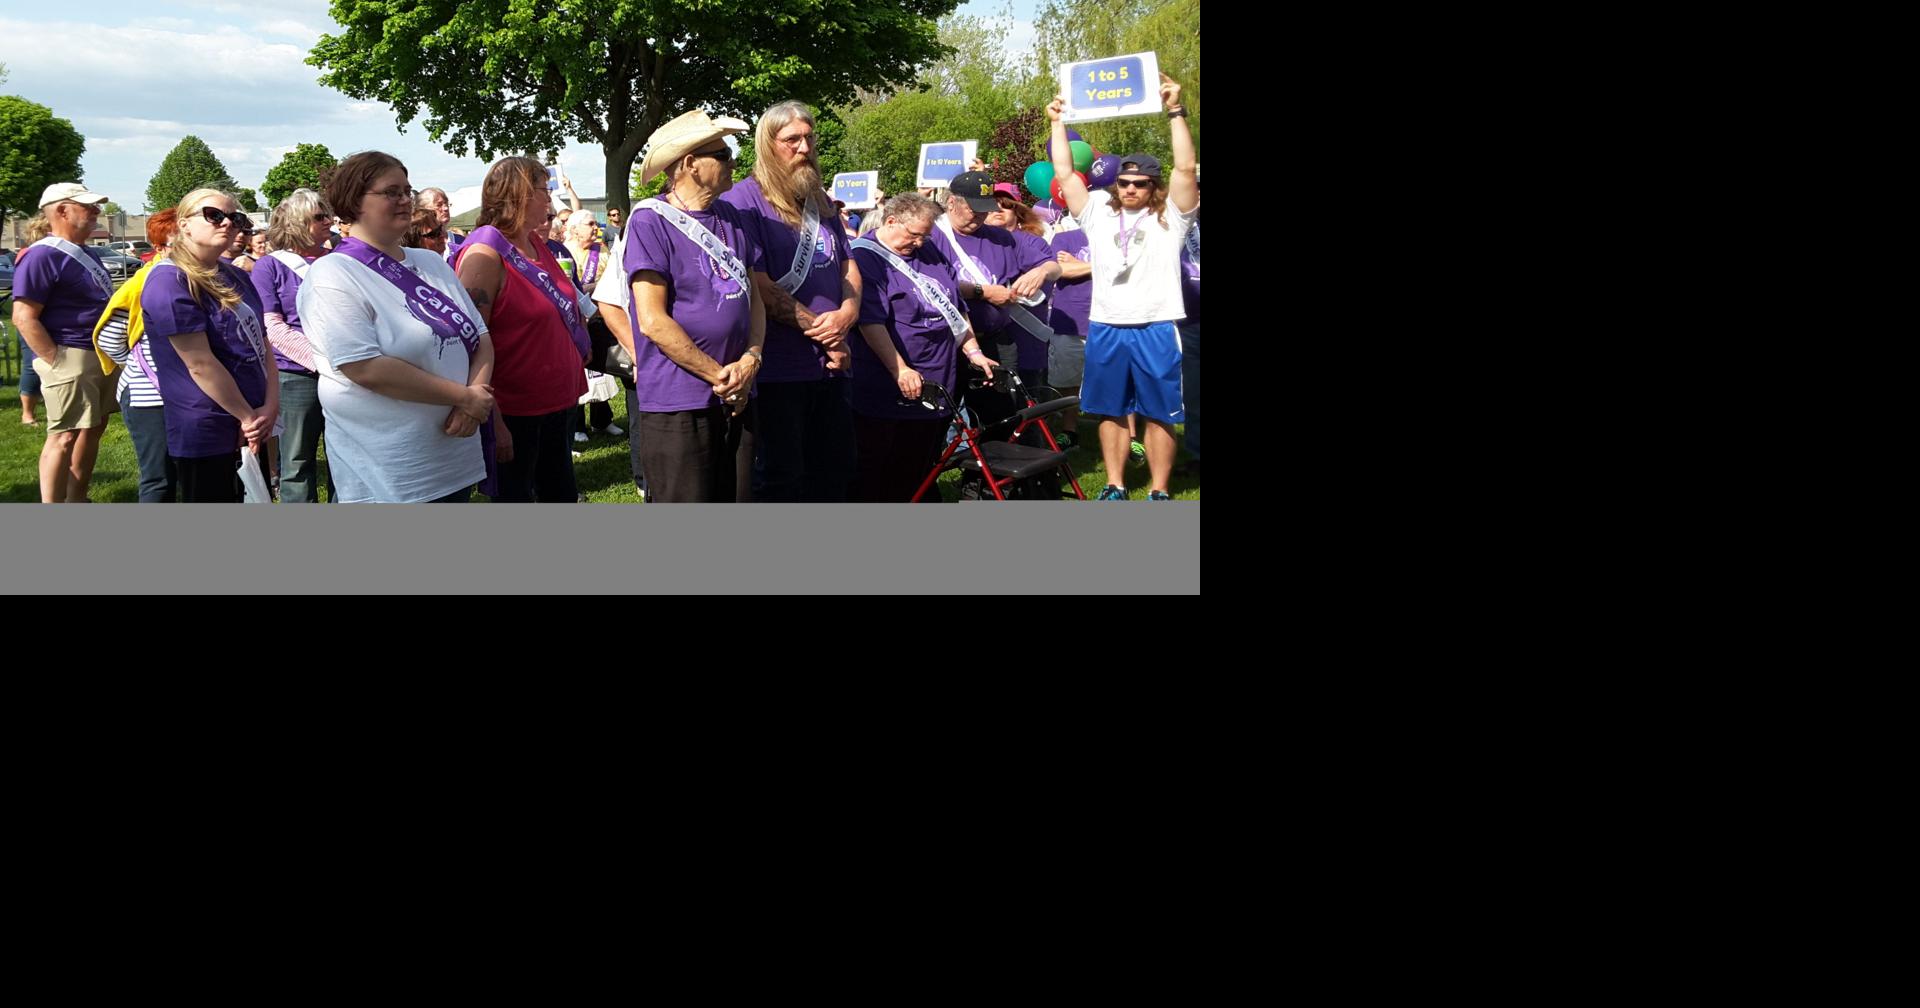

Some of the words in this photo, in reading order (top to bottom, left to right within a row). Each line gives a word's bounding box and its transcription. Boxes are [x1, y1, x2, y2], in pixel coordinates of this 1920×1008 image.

[1088, 71, 1095, 83] 1
[1098, 70, 1116, 81] to
[1119, 66, 1129, 80] 5
[1086, 87, 1133, 101] Years
[837, 180, 845, 188] 10
[846, 179, 867, 187] Years
[980, 183, 993, 196] M
[794, 229, 813, 276] Survivor
[926, 282, 960, 322] Survivor
